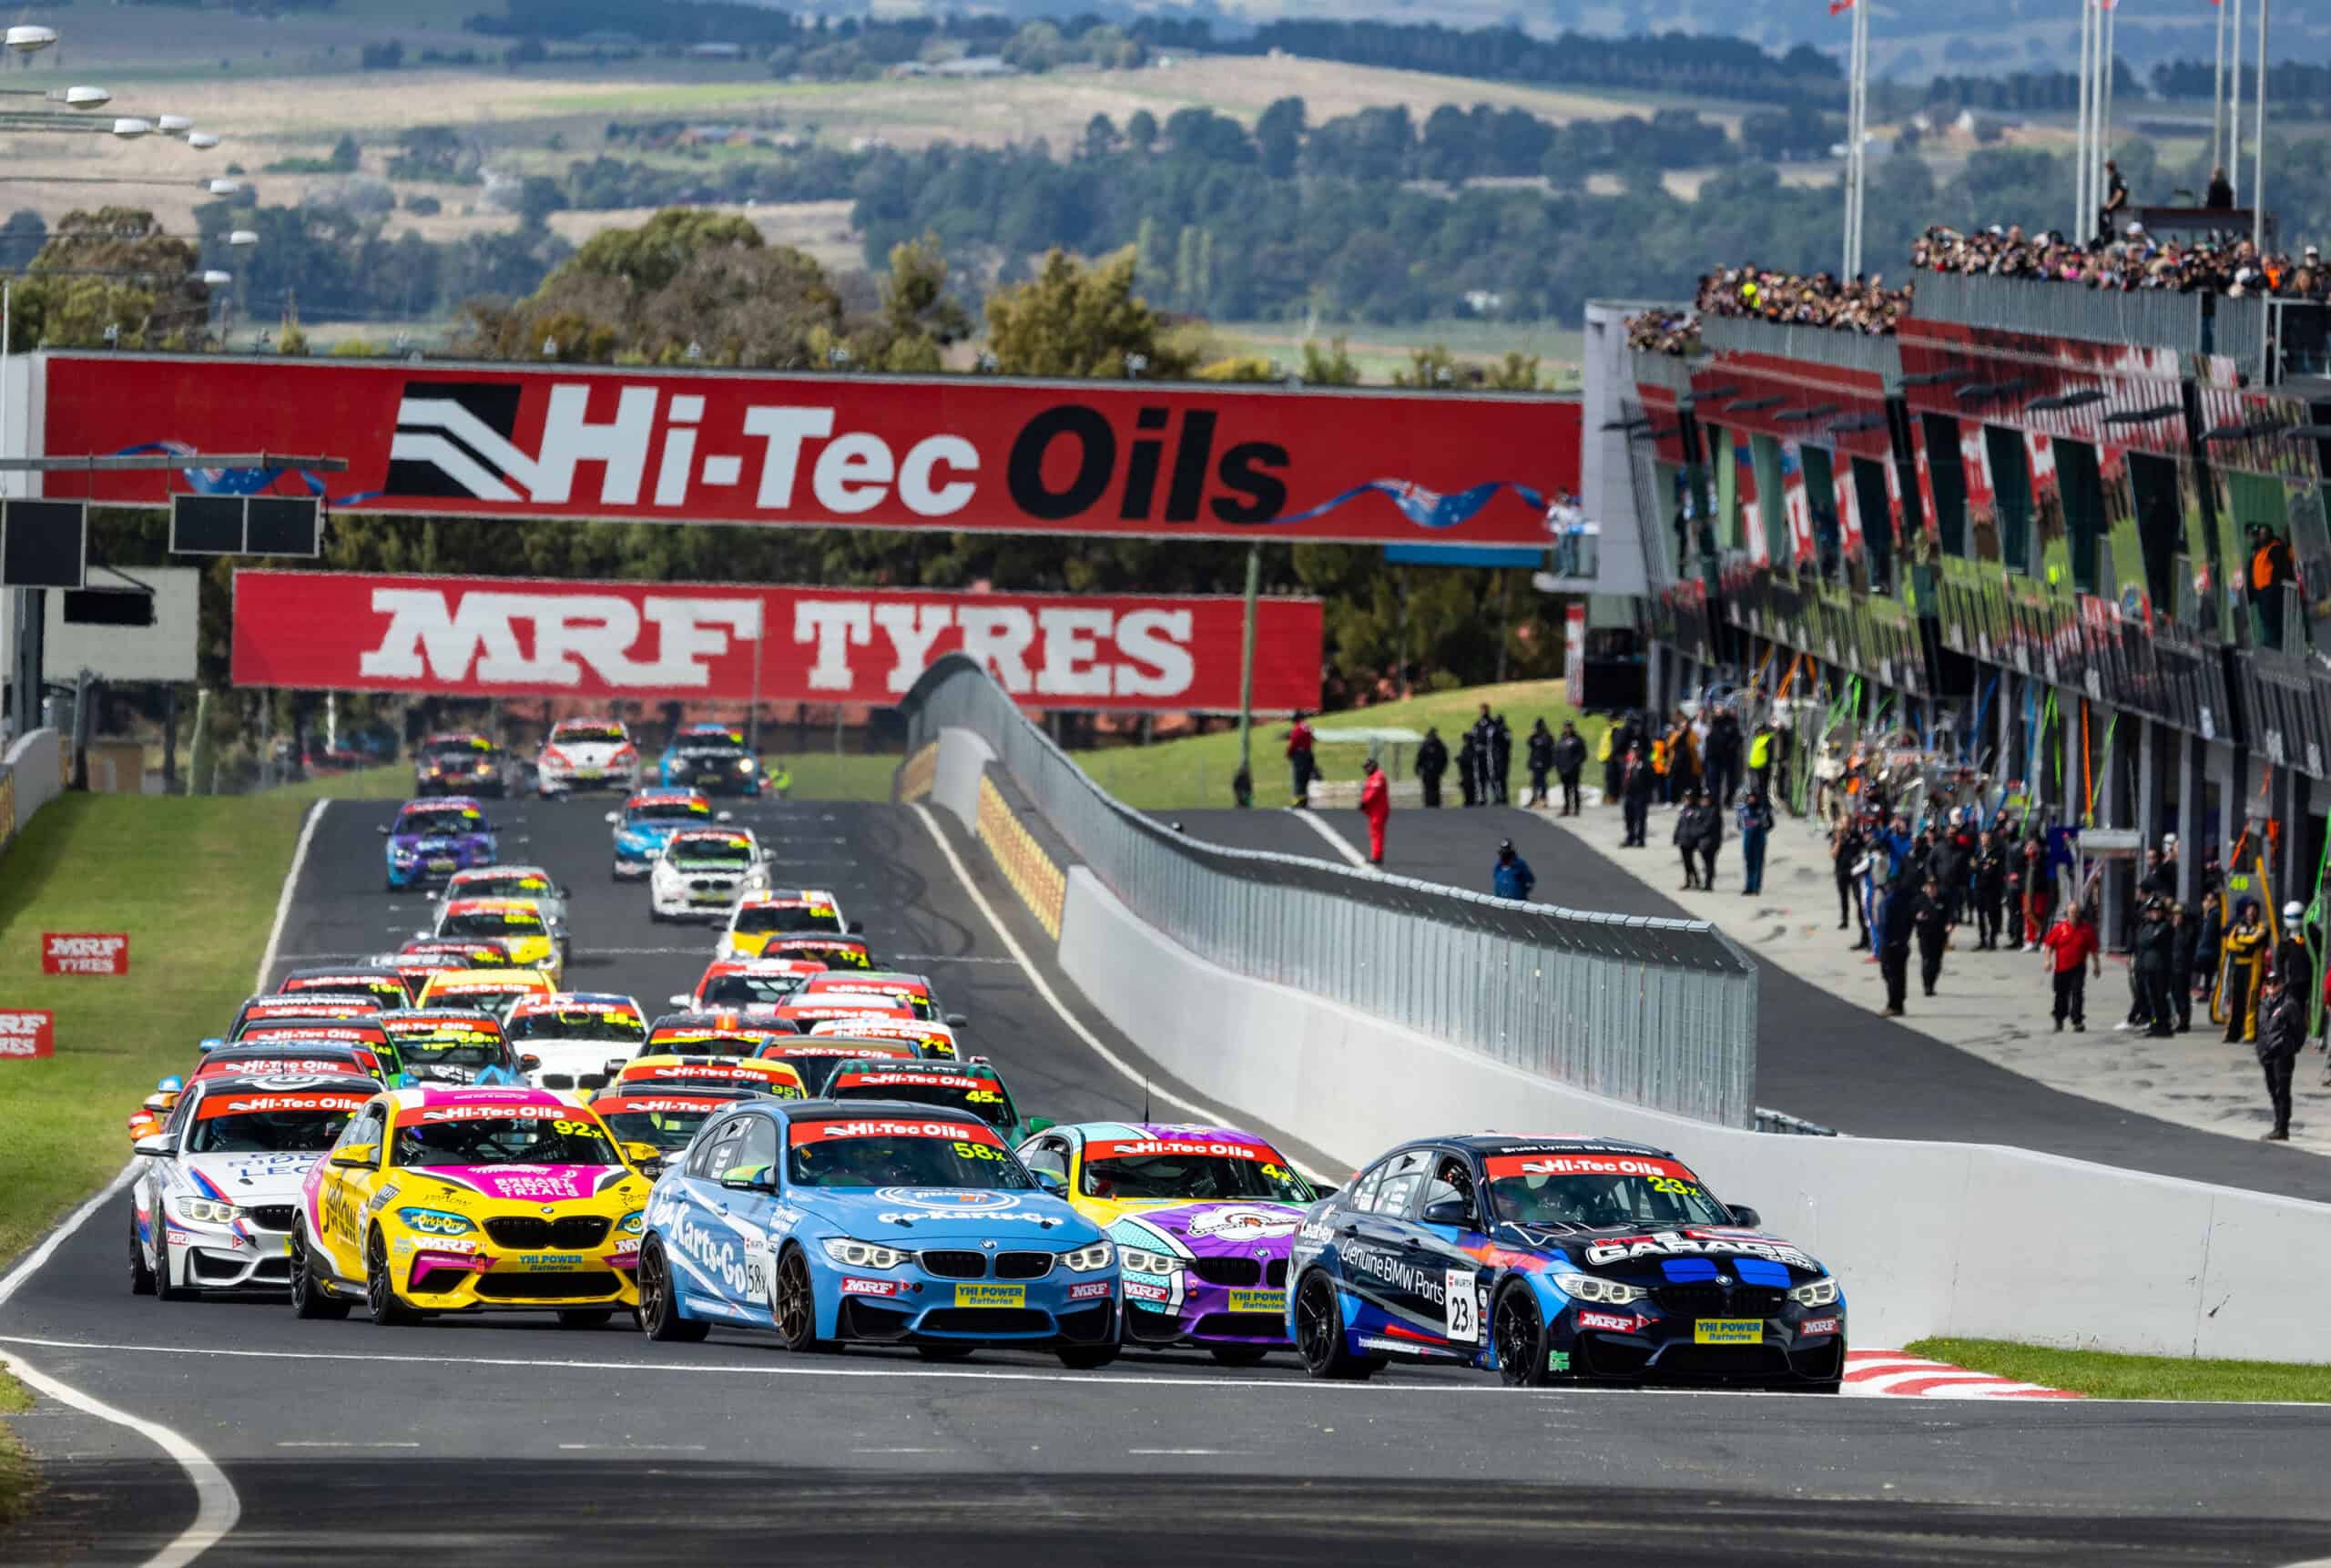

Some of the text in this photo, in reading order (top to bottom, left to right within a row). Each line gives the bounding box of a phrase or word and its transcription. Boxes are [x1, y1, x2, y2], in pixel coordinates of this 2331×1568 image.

[532, 383, 1290, 524] Hi-Tec Oils
[361, 587, 1194, 697] MRF TYRES
[47, 937, 124, 956] MRF
[58, 958, 114, 972] TYRES
[0, 1013, 46, 1034] RF
[0, 1037, 36, 1055] RES
[672, 1067, 768, 1080] Hi-Tec Oils
[879, 1074, 978, 1087] Hi-Tec Oils
[249, 1097, 363, 1110] Hi-Tec Oils
[965, 1090, 1003, 1104] 45
[446, 1106, 565, 1119] Hi-Tec Oils
[647, 1101, 713, 1112] Hi-Tec
[846, 1122, 970, 1139] Hi-Tec Oils
[1135, 1140, 1255, 1157] Hi-Tec Oils
[1544, 1159, 1664, 1176] Hi-Tec Oils
[494, 1176, 569, 1186] BREAST
[498, 1182, 574, 1191] CANCER
[502, 1186, 580, 1197] TRIALS
[519, 1254, 583, 1264] YHI POWER
[1586, 1240, 1807, 1266] GARAGE
[1340, 1237, 1383, 1278] Genuine
[1383, 1257, 1414, 1292] BMW
[1415, 1270, 1444, 1306] Parts
[844, 1279, 895, 1295] MRF
[959, 1286, 1023, 1297] YHI POWER
[1071, 1283, 1108, 1298] MRF
[1124, 1281, 1166, 1299] MRF
[969, 1296, 1013, 1305] Batteries
[1232, 1291, 1287, 1302] YHI POWE
[1242, 1302, 1287, 1311] Batterie
[1583, 1312, 1633, 1330] MRF
[1697, 1321, 1761, 1332] YHI POWER
[1803, 1320, 1837, 1334] MRF
[1708, 1331, 1753, 1341] Batteries
